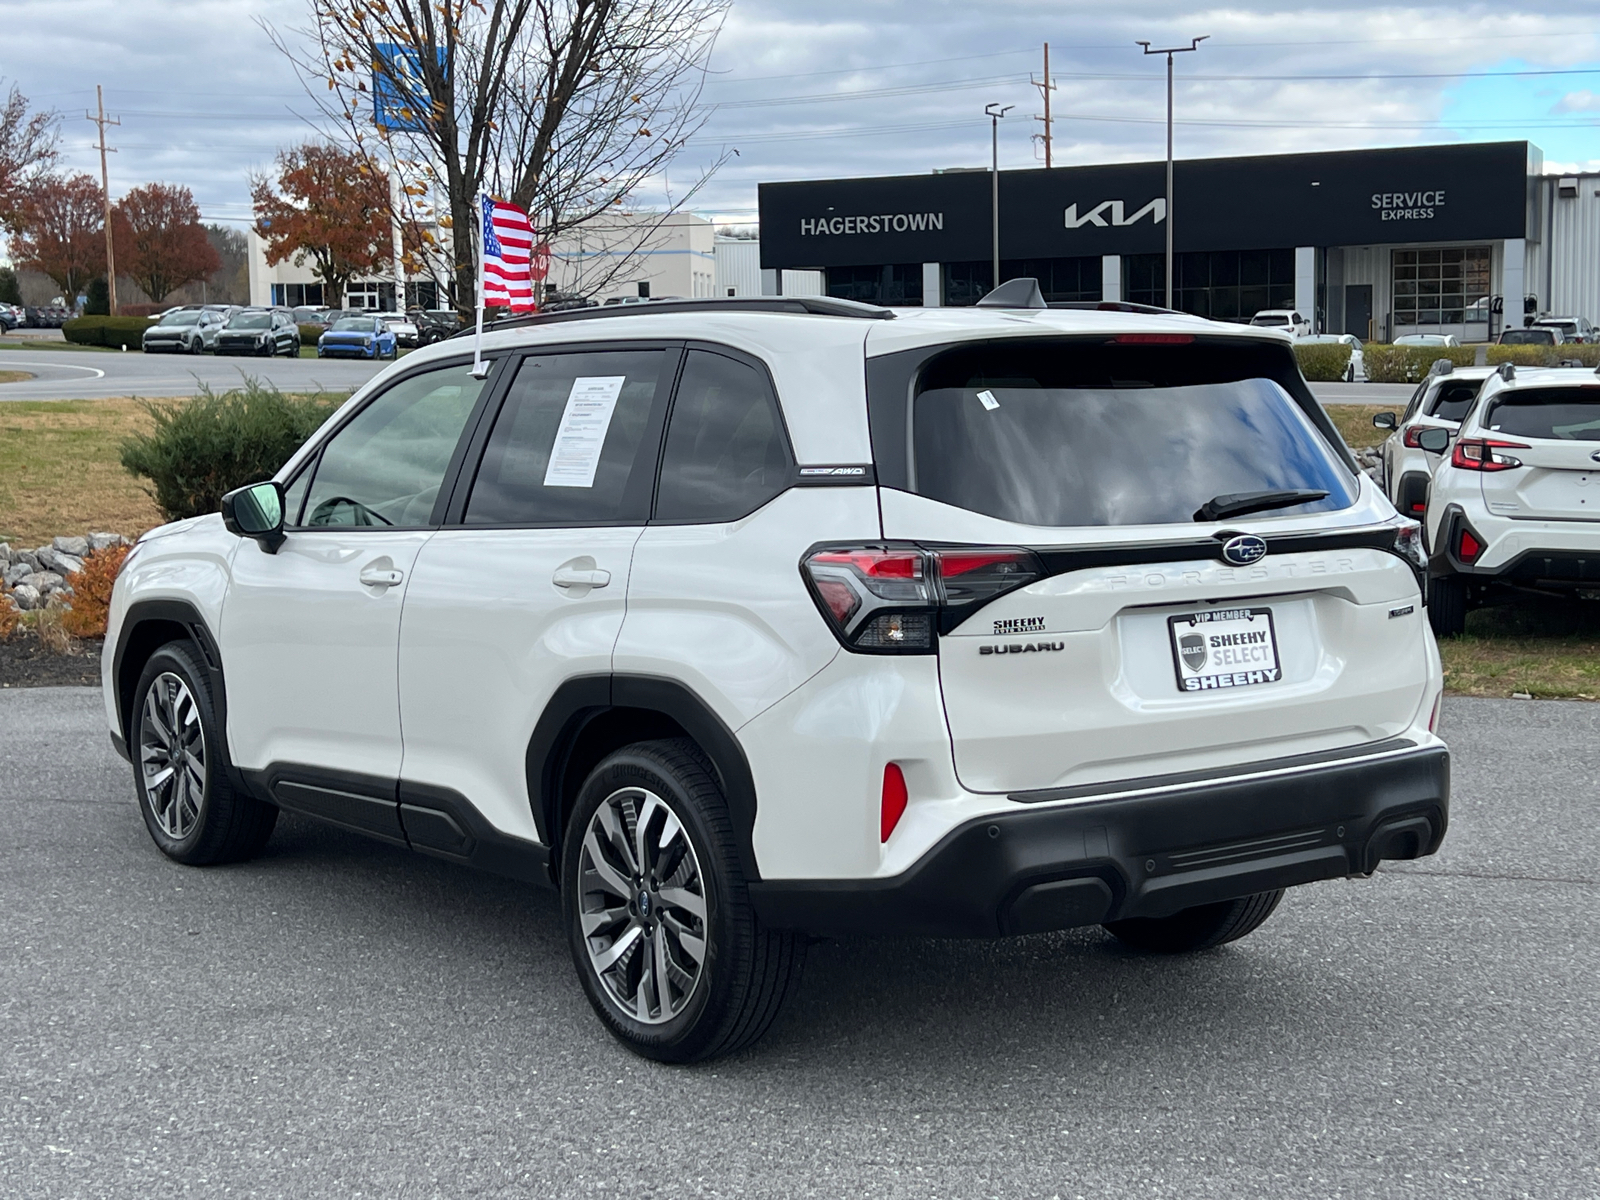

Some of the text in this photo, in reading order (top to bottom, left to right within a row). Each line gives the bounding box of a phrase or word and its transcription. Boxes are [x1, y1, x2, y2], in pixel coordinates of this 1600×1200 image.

[1371, 190, 1446, 209] SERVICE
[1064, 198, 1167, 229] KIA
[1381, 207, 1434, 221] EXPRESS
[800, 212, 944, 236] HAGERSTOWN
[831, 466, 864, 475] AWD
[1106, 557, 1355, 590] FORESTER
[993, 616, 1045, 629] SHEEHY
[1194, 609, 1251, 623] VIP MEMBER
[979, 641, 1065, 655] SUBARU
[1209, 630, 1267, 648] SHEEHY
[1182, 645, 1205, 656] SELECT
[1213, 645, 1269, 667] SELECT
[1185, 668, 1279, 691] SHEEHY
